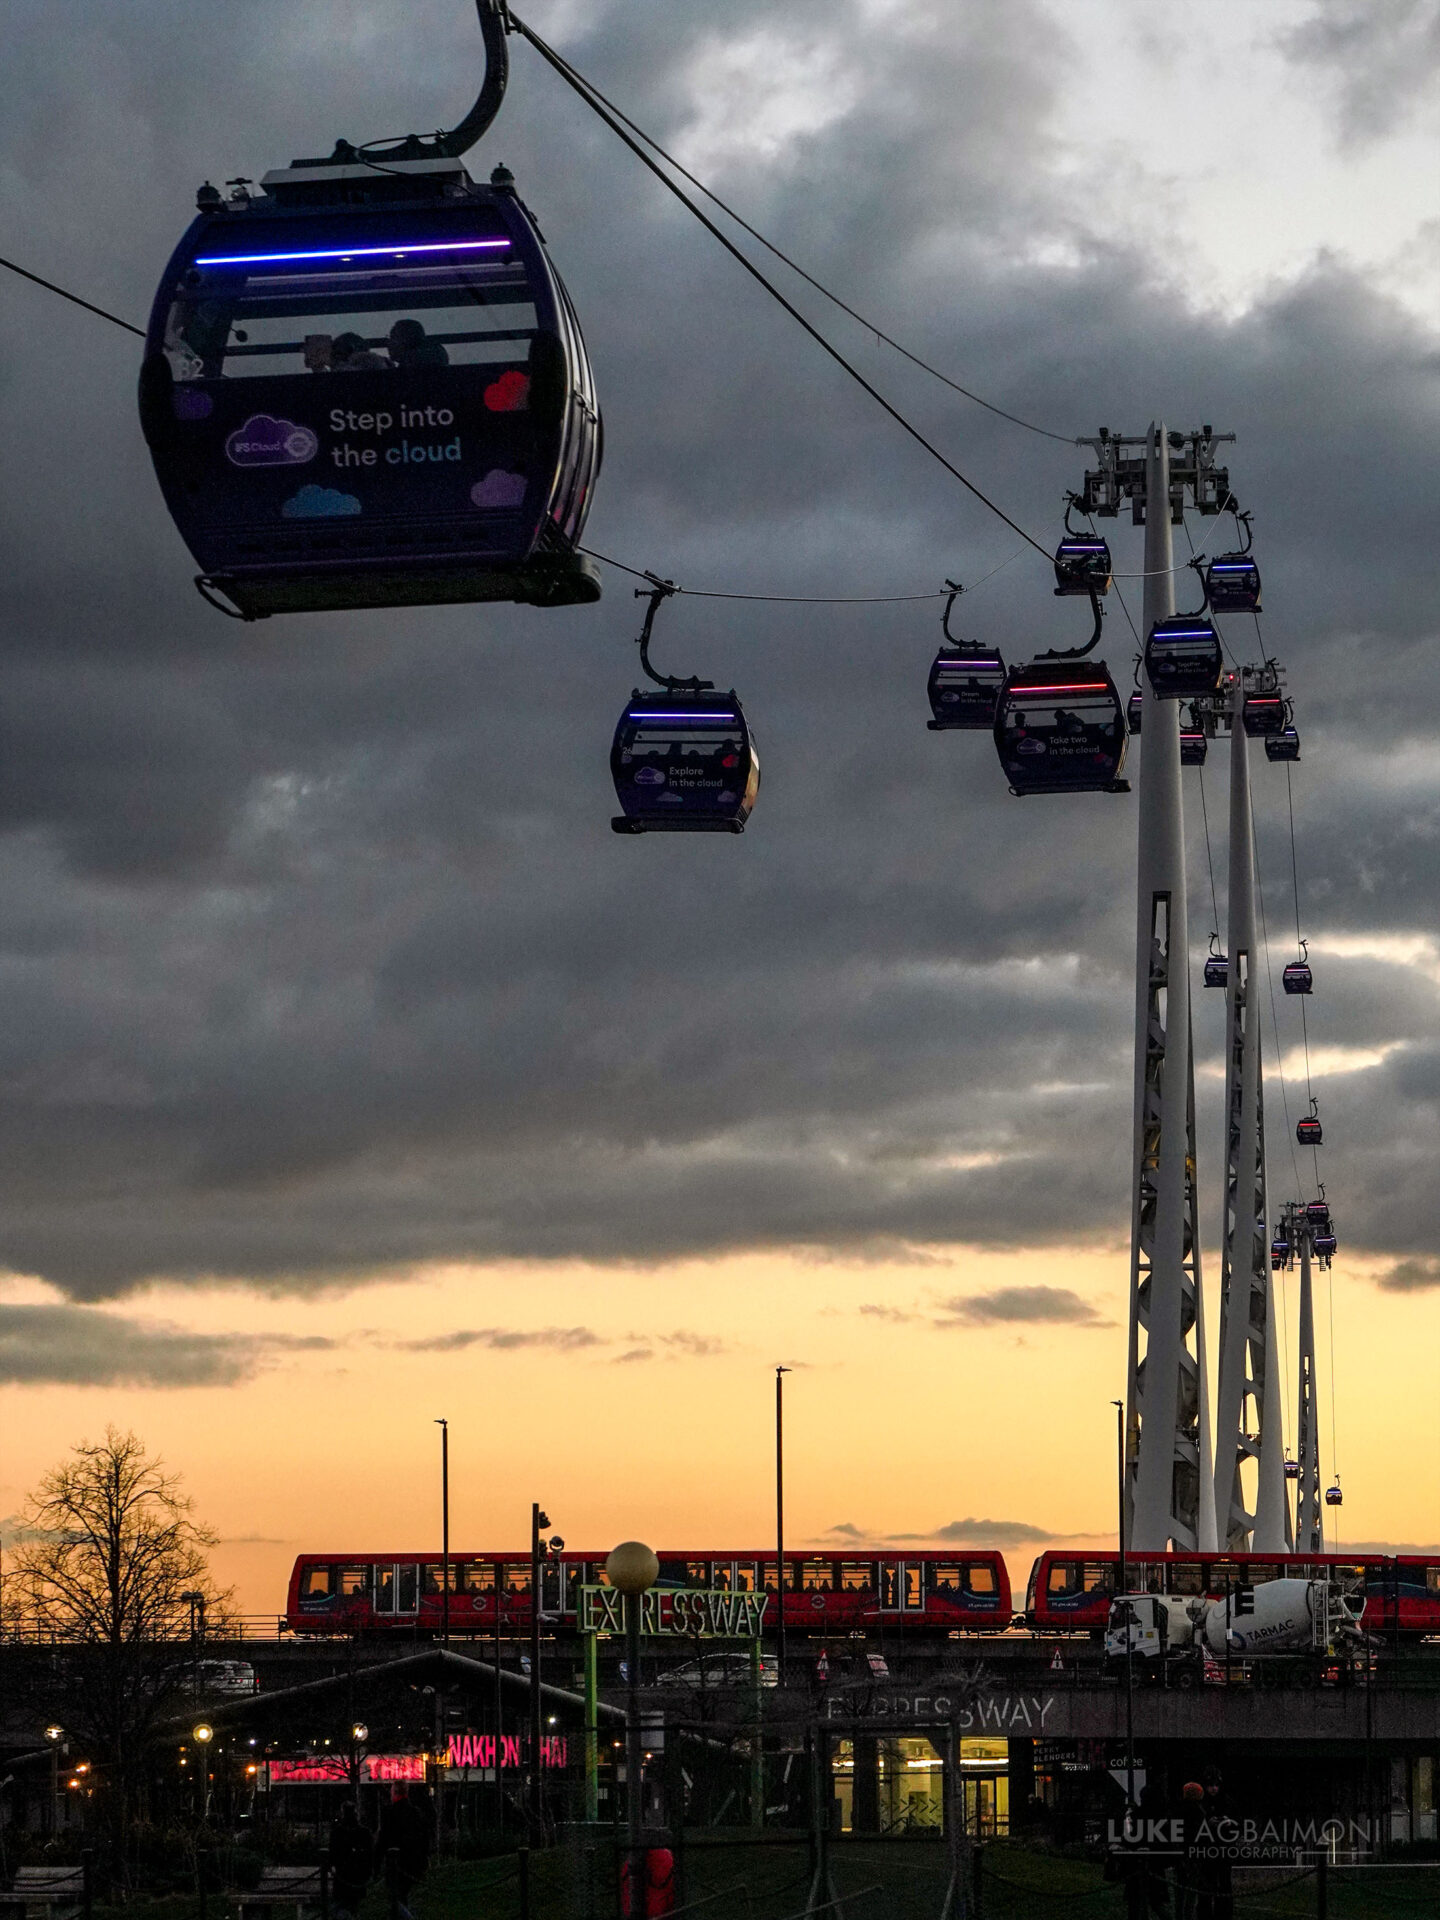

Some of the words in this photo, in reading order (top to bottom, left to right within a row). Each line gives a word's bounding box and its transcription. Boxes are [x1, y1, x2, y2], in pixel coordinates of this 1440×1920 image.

[329, 408, 393, 436] Step
[400, 403, 454, 428] into
[331, 442, 378, 467] the
[385, 436, 462, 464] cloud
[1049, 735, 1069, 744] Take
[1049, 746, 1058, 755] in
[1059, 746, 1074, 755] the
[1075, 745, 1100, 754] cloud
[669, 766, 704, 777] Explore
[669, 778, 678, 787] in
[680, 778, 695, 787] the
[697, 778, 723, 787] cloud
[583, 1588, 769, 1636] EXRESSWAY
[1246, 1619, 1295, 1641] TARMAC
[527, 1735, 566, 1768] HAI
[1109, 1755, 1143, 1767] cofee
